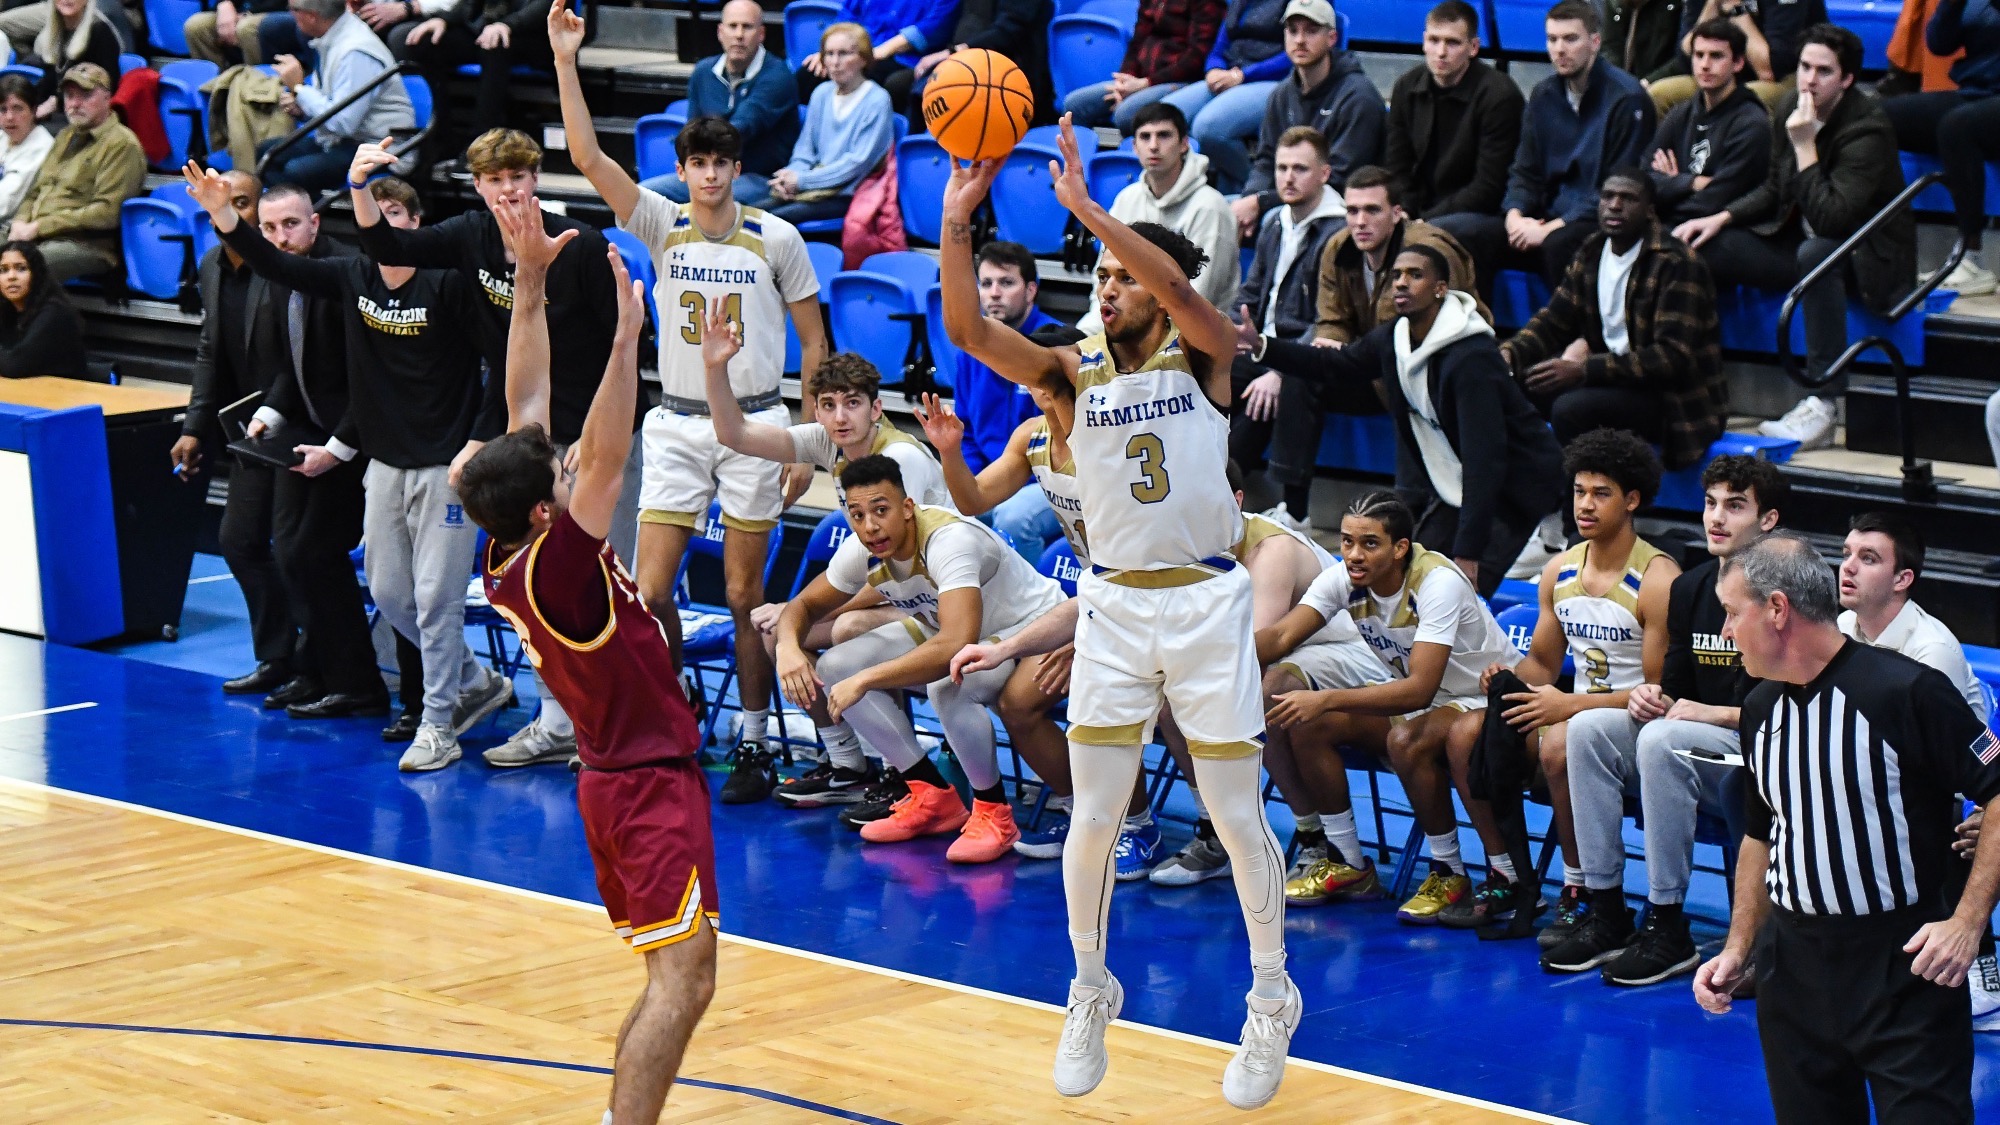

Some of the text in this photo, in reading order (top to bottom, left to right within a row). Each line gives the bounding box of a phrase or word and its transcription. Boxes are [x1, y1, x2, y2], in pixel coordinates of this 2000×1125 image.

[669, 265, 757, 284] HAMILTON
[357, 295, 428, 324] HAMILTON
[679, 290, 745, 348] 34
[1086, 393, 1195, 427] HAMILTON
[1126, 432, 1171, 504] 3
[1583, 648, 1614, 694] 2
[1698, 656, 1733, 666] BASKE
